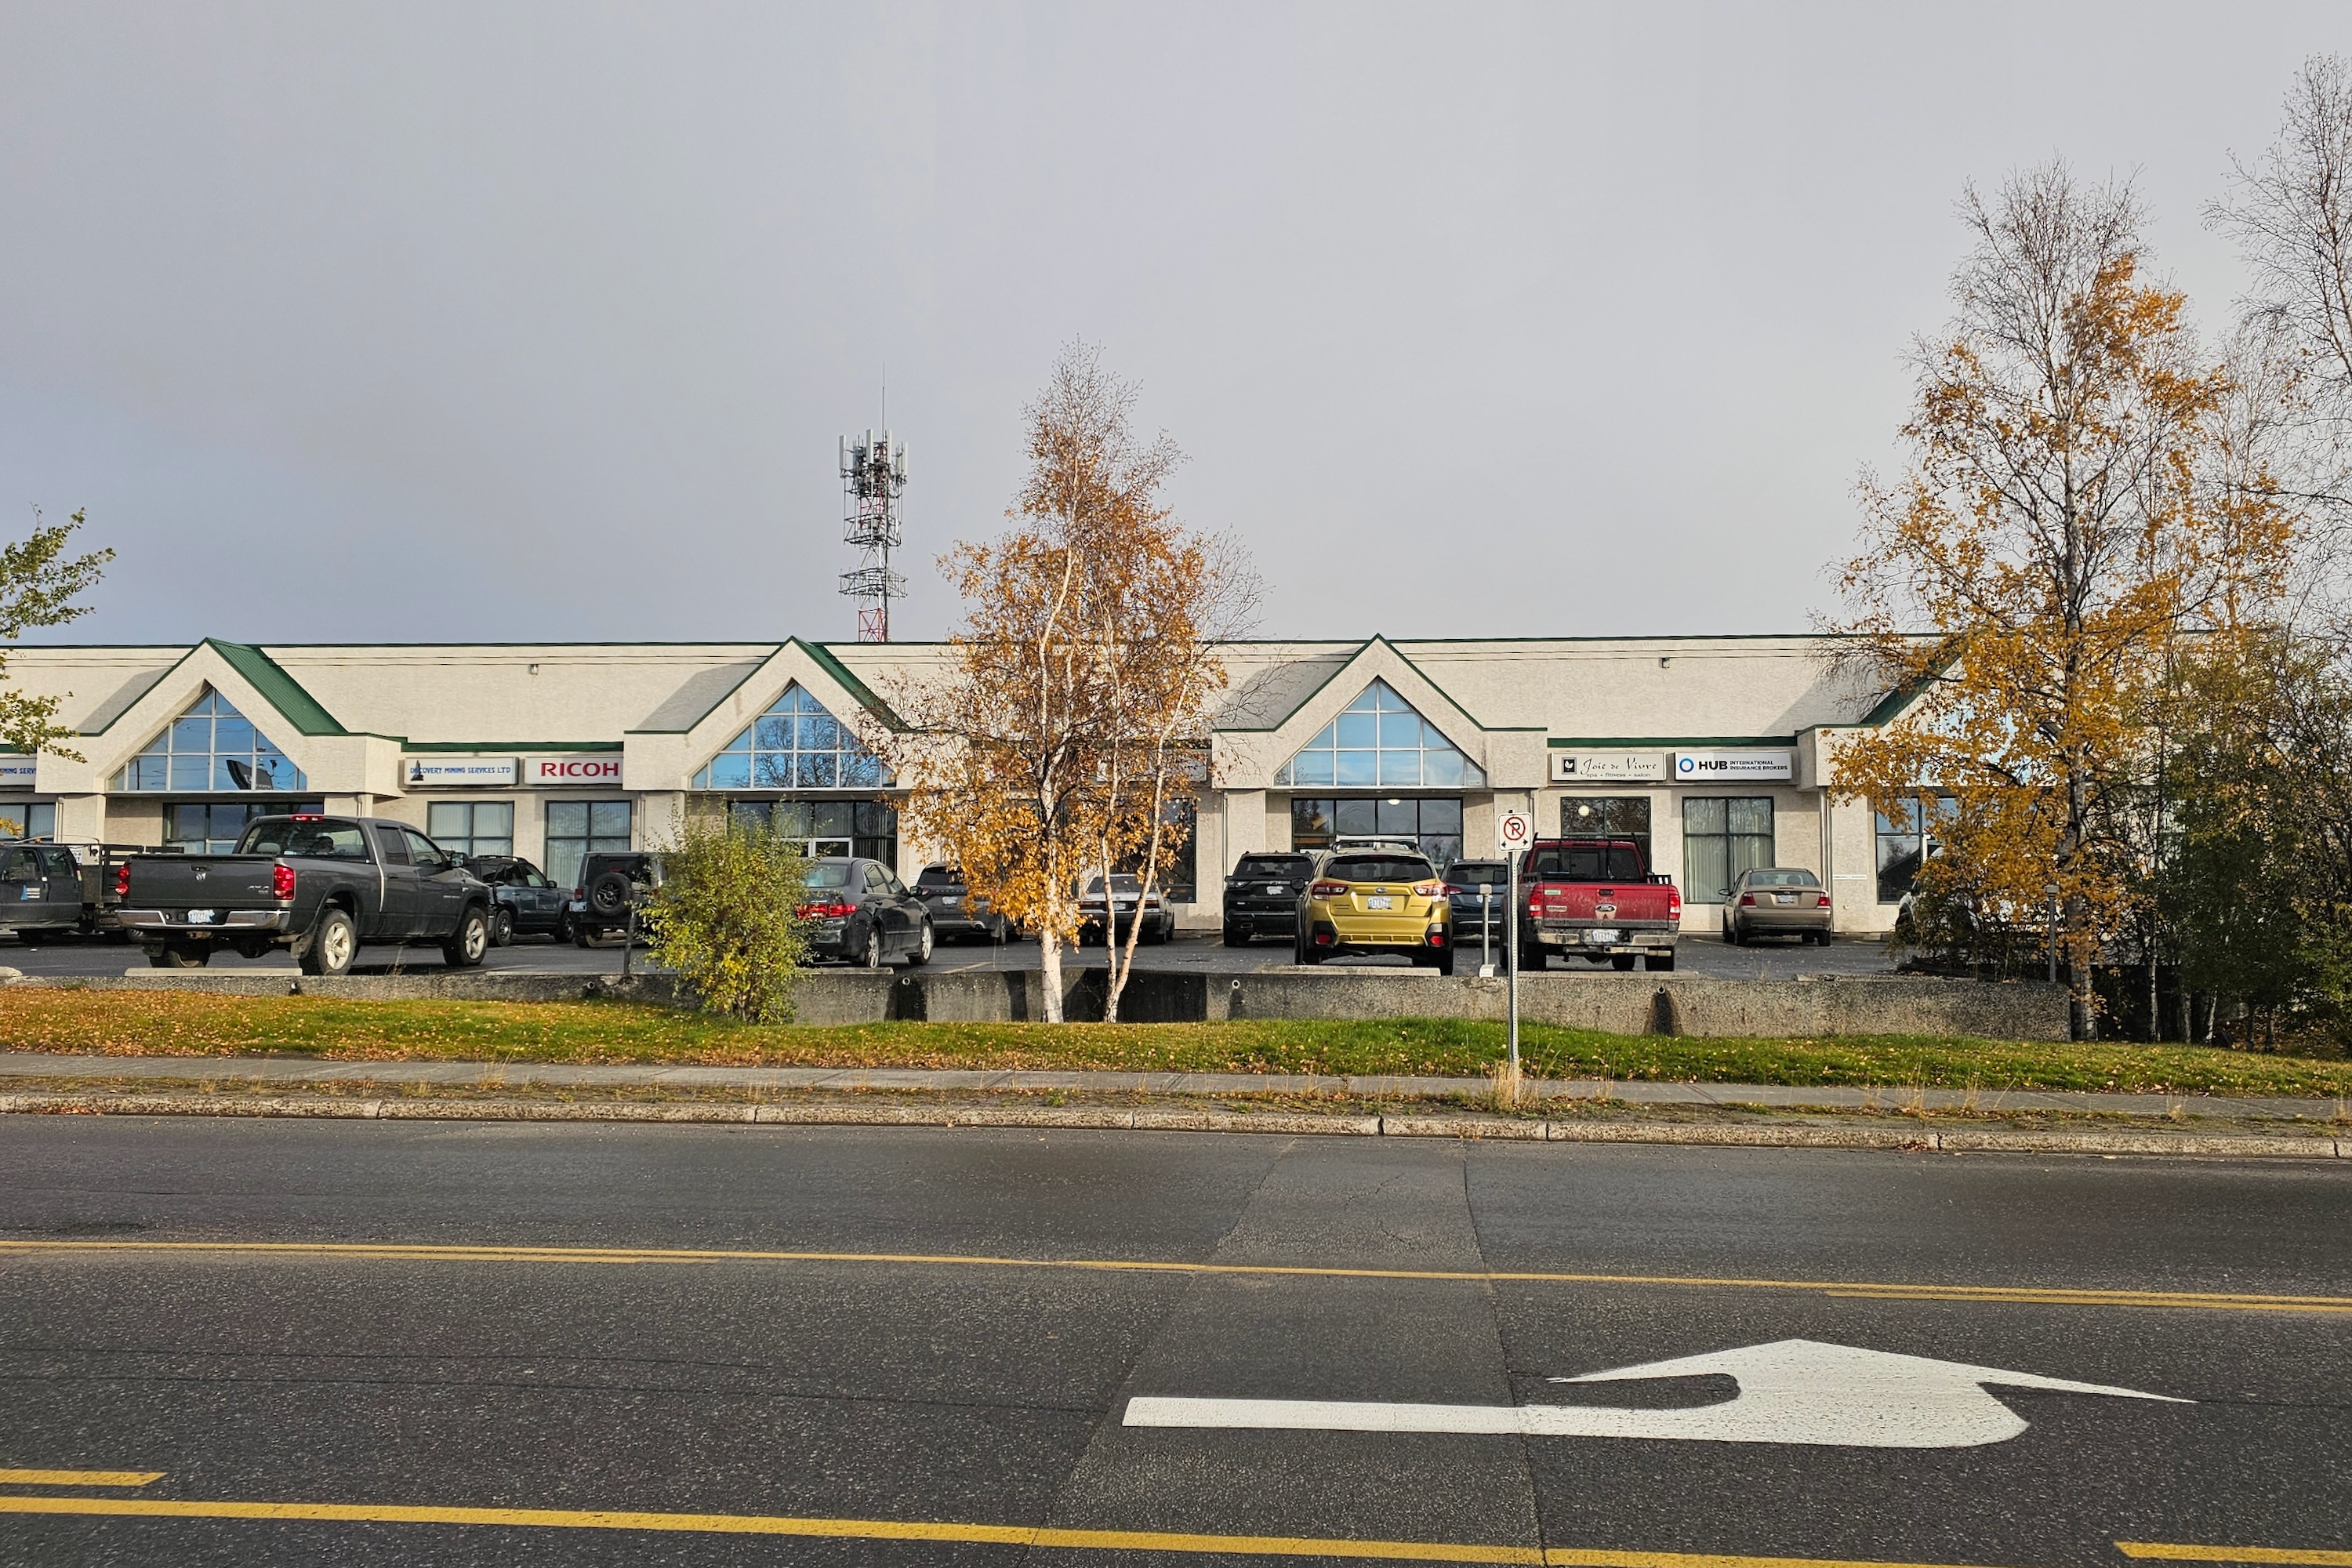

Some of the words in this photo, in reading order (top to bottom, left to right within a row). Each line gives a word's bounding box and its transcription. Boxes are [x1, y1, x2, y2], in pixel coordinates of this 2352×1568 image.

[541, 762, 619, 776] RICOH
[1581, 757, 1606, 775] Joie
[1625, 757, 1657, 771] Vivre
[1698, 760, 1728, 770] HUB
